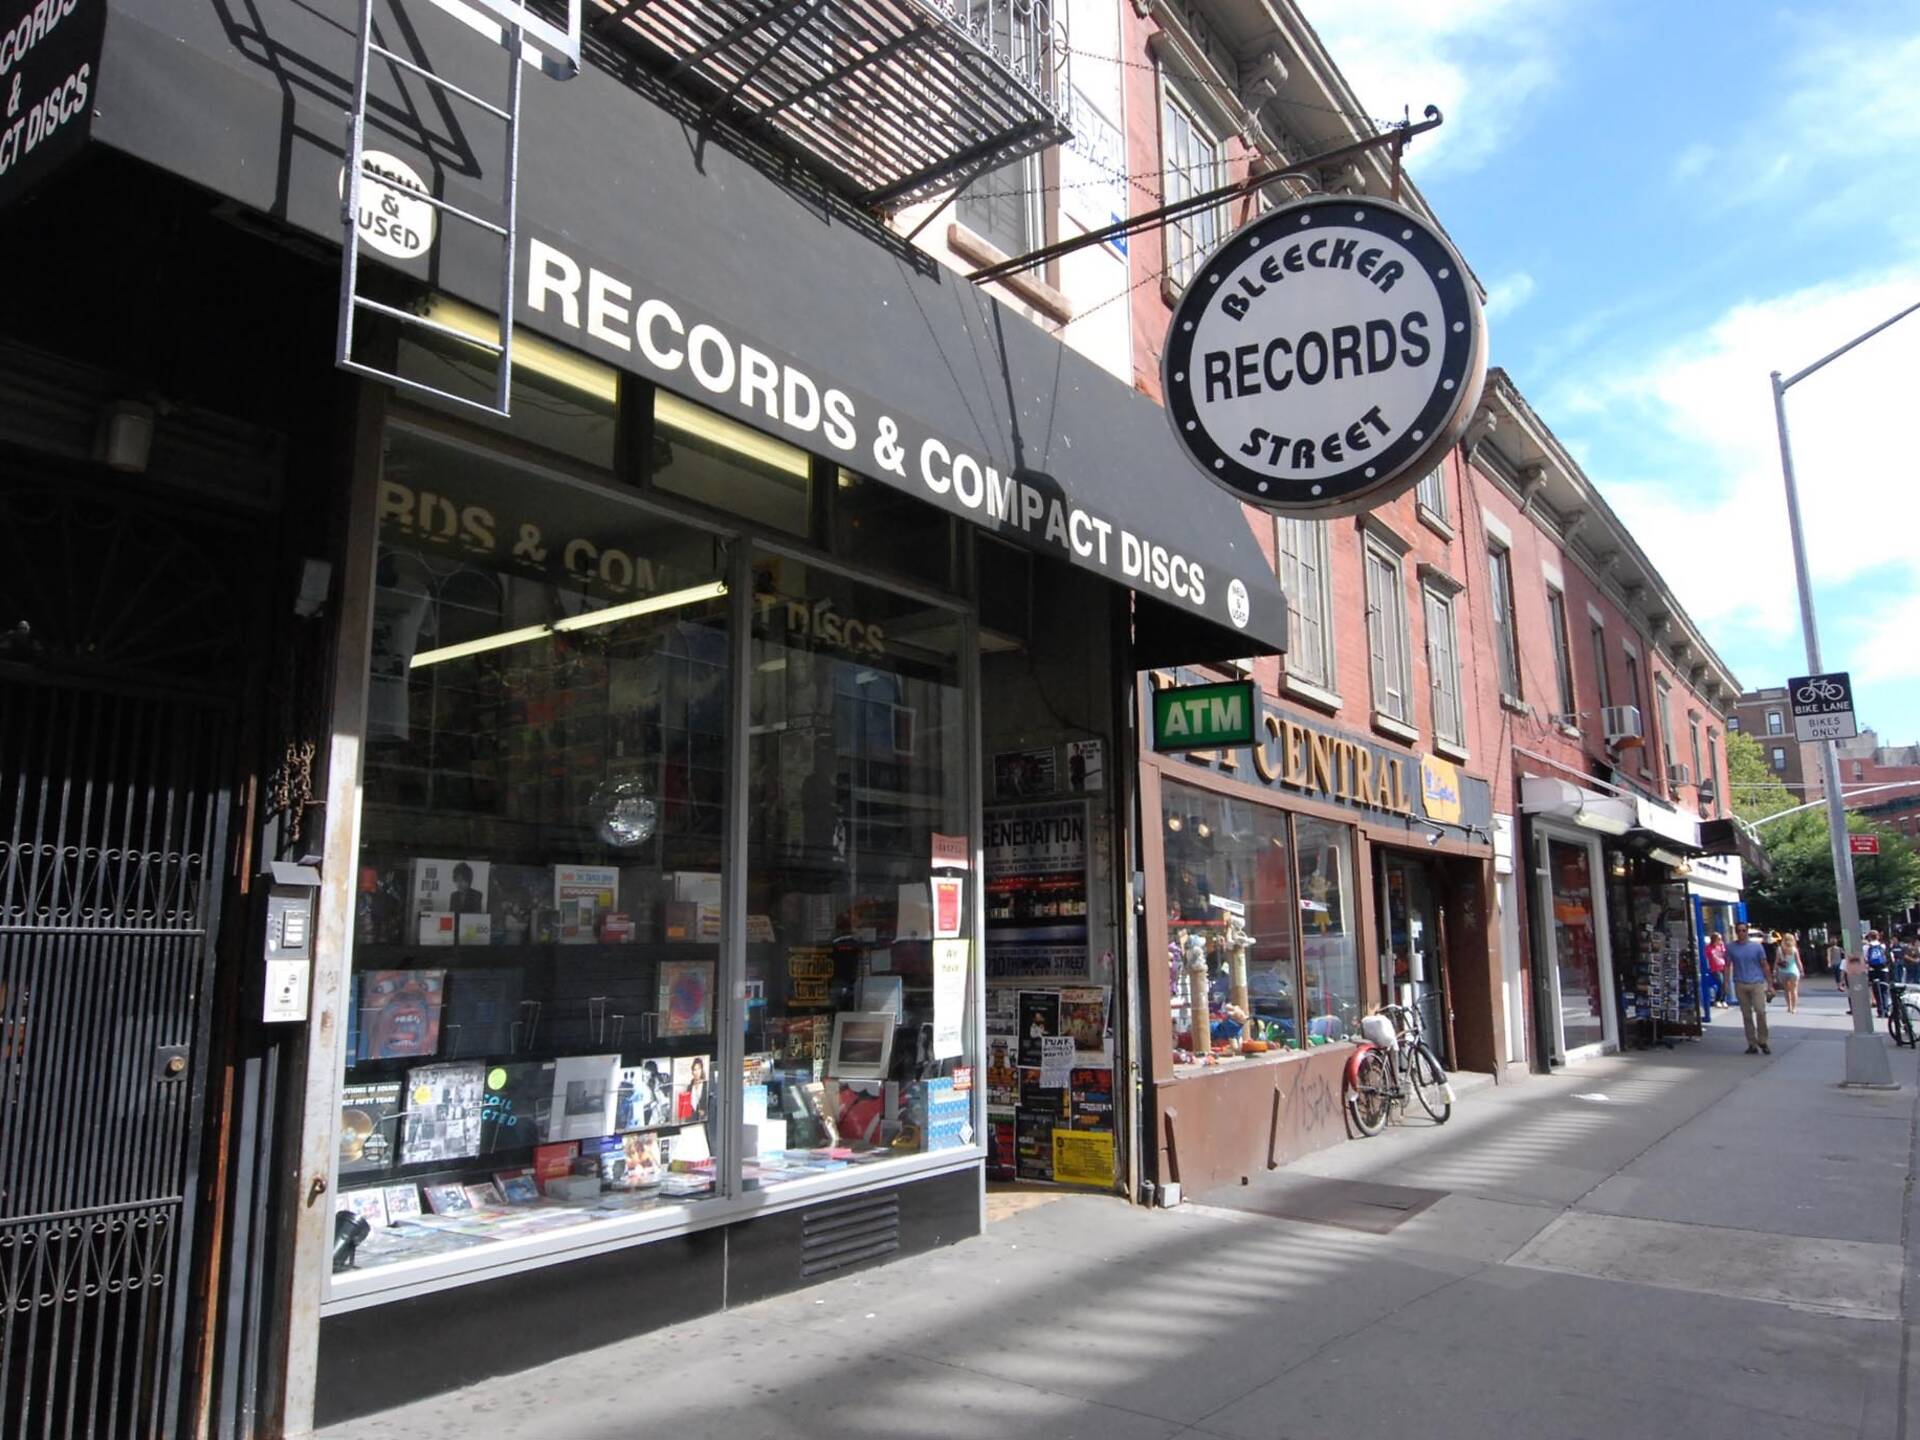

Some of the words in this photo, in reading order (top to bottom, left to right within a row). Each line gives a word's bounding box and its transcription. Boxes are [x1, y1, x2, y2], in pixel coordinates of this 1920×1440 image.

[0, 0, 77, 75] CORD
[0, 117, 25, 175] CT
[25, 63, 90, 154] DISCS
[7, 72, 22, 118] &
[359, 206, 420, 250] USED
[381, 194, 400, 219] &
[1221, 238, 1405, 321] BLEECKER
[1204, 311, 1431, 403] RECORDS
[527, 237, 858, 451] RECORDS
[873, 416, 907, 479] &
[920, 437, 1112, 566] COMPACT
[1120, 535, 1206, 606] DISCS
[1240, 405, 1392, 469] STREET
[380, 481, 496, 552] RDS
[1164, 695, 1243, 736] ATM
[1795, 704, 1819, 714] BIKE
[1822, 701, 1851, 712] LANE
[1808, 716, 1841, 728] BIKES
[1812, 727, 1840, 737] ONLY
[1254, 711, 1412, 815] CENTRAL
